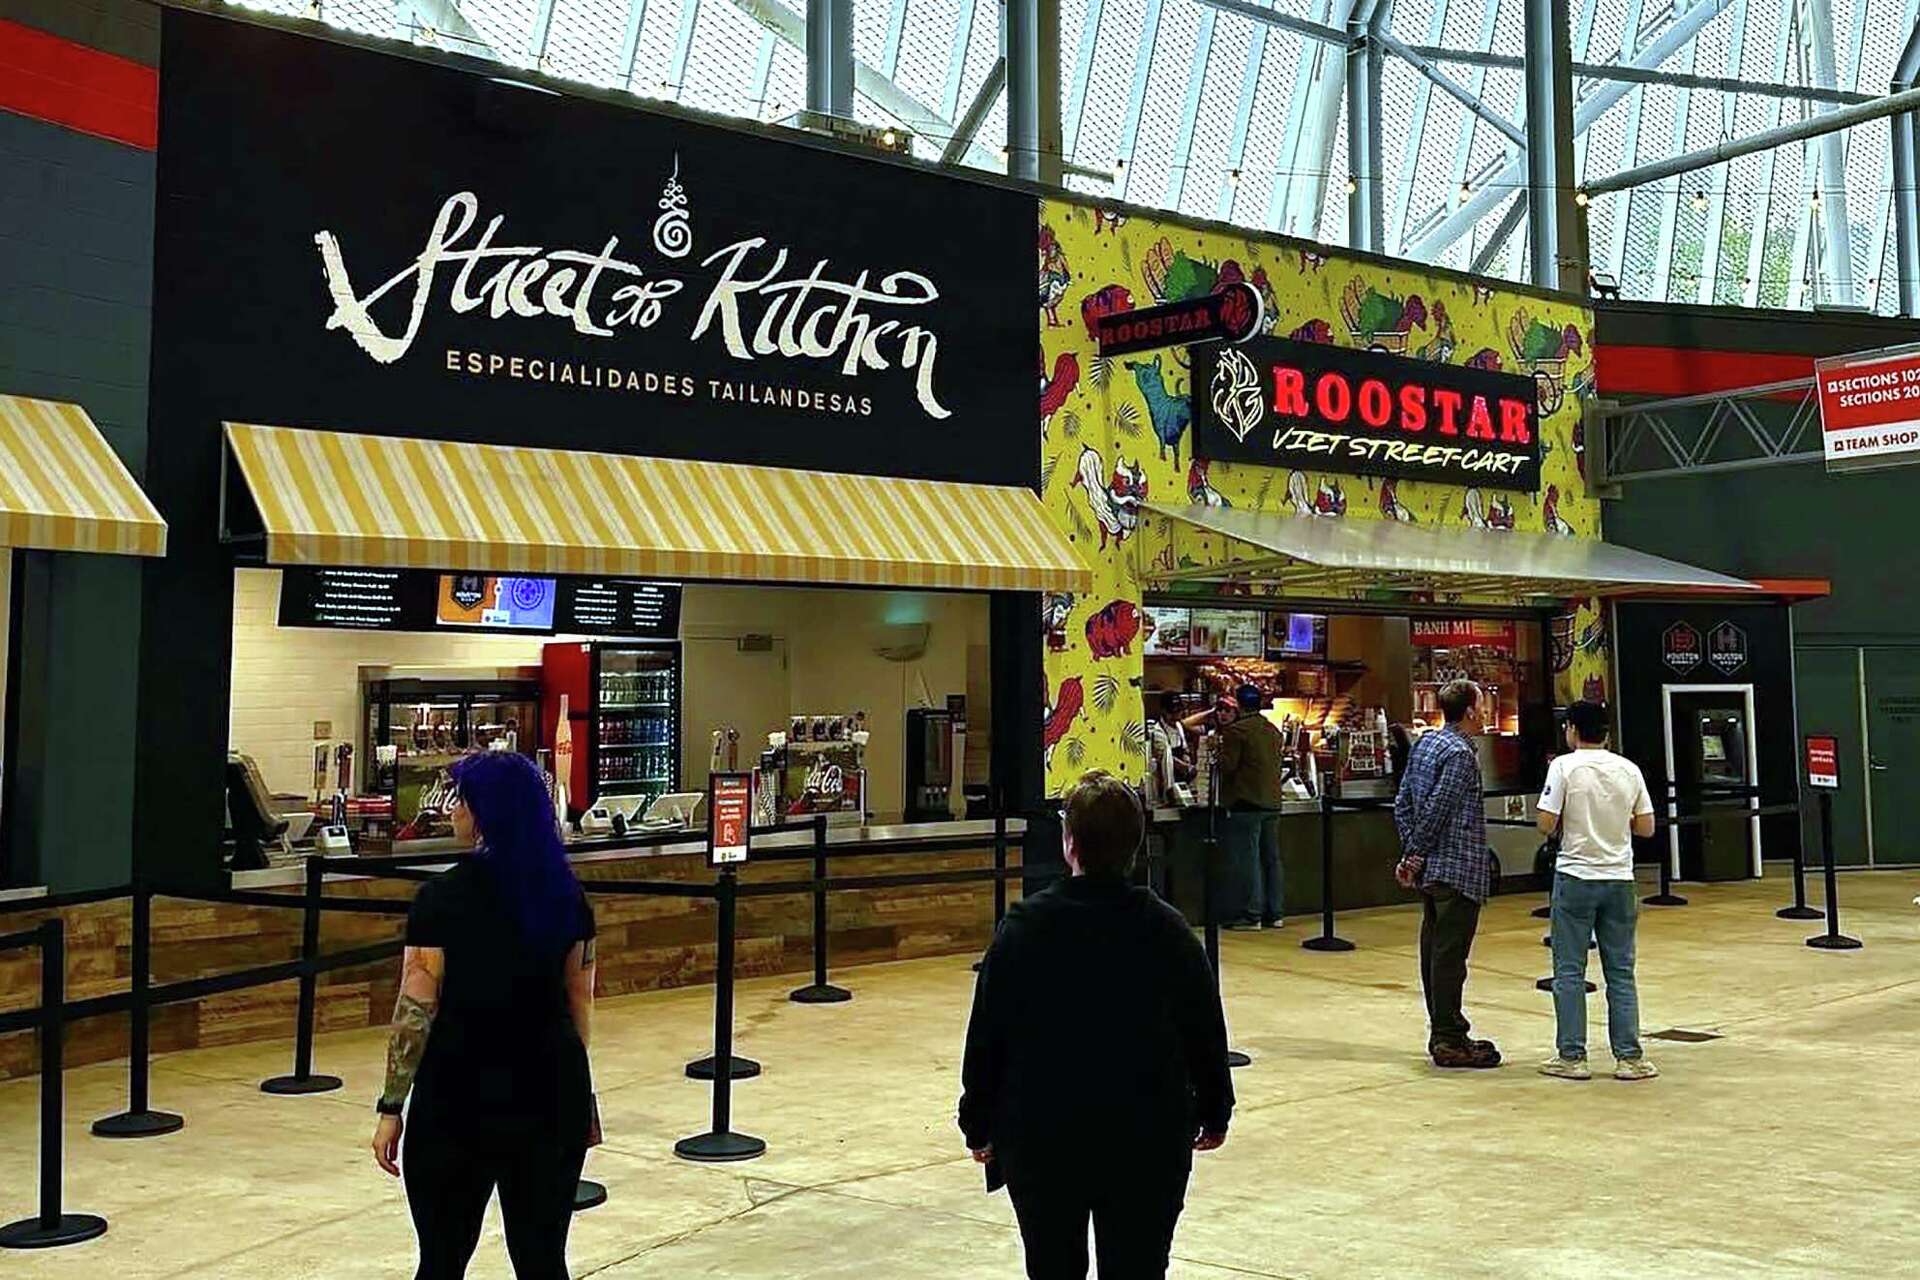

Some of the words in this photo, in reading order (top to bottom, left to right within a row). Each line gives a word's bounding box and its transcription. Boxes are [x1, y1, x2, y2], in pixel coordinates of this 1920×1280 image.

[313, 191, 643, 363] Street
[691, 237, 952, 420] Kitchen
[1101, 307, 1212, 346] ROOSTAR
[446, 349, 696, 397] ESPECIALIDADES
[708, 380, 873, 416] TAILANDESAS
[1838, 372, 1899, 392] SECTIONS
[1840, 388, 1901, 407] SECTIONS
[1272, 366, 1532, 444] ROOSTAR
[1271, 427, 1351, 455] VIET
[1348, 436, 1530, 474] STREET-CART
[1846, 436, 1879, 450] TEAM
[1882, 431, 1918, 446] SHOP
